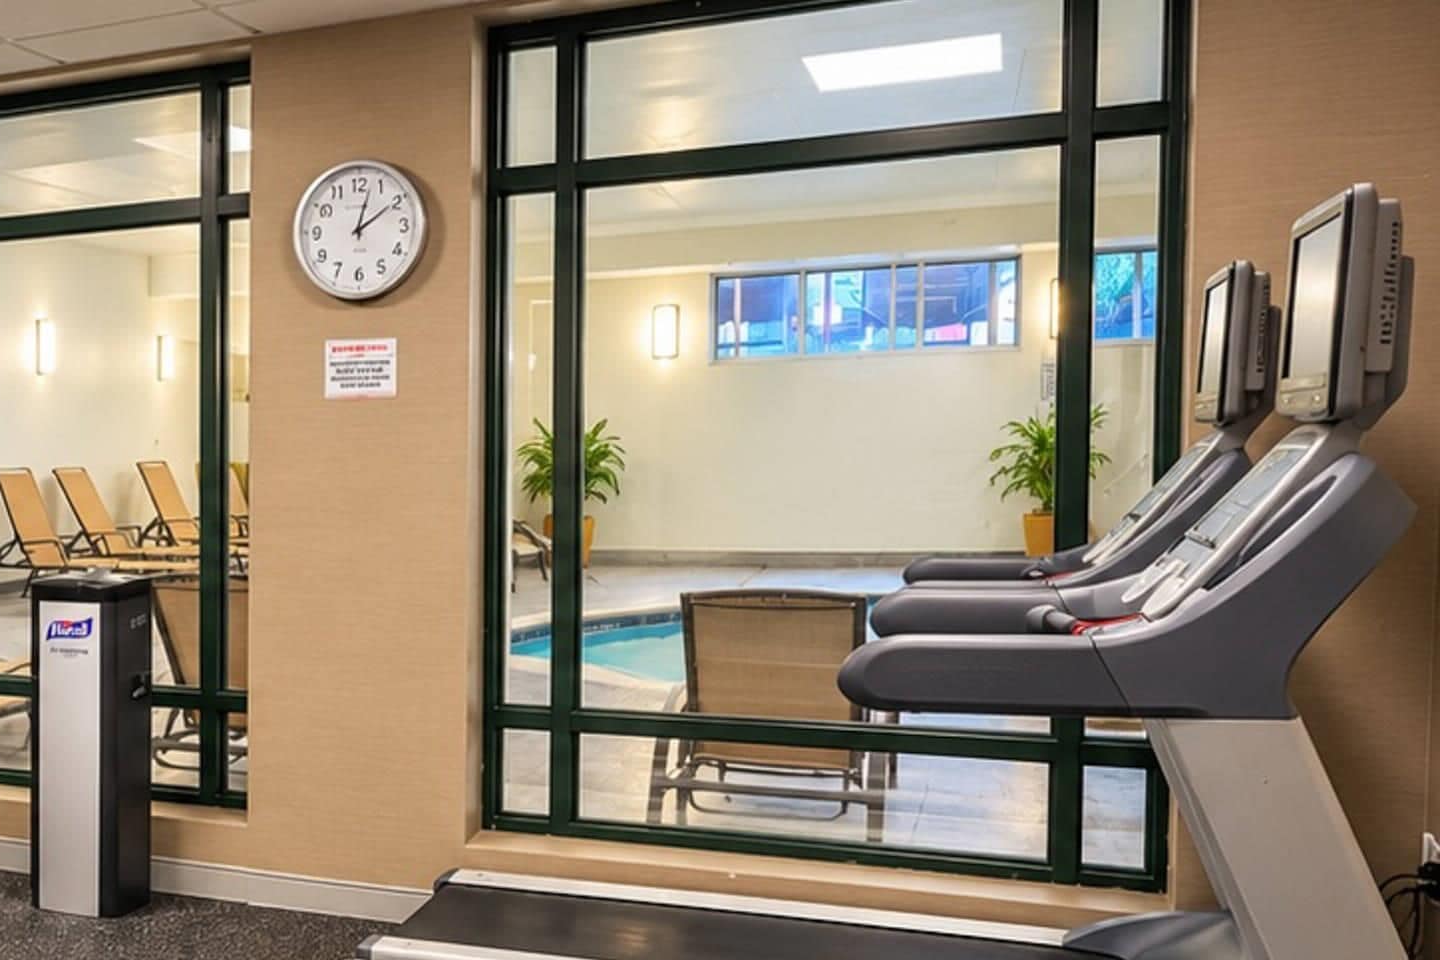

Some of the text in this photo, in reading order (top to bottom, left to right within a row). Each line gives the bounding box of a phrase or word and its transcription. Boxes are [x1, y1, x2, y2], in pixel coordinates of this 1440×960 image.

[351, 177, 368, 193] 12
[378, 178, 383, 195] 1
[391, 194, 403, 210] 2
[311, 225, 322, 241] 9
[399, 217, 410, 234] 3
[333, 261, 342, 278] 7
[354, 267, 364, 281] 6
[376, 258, 386, 275] 5
